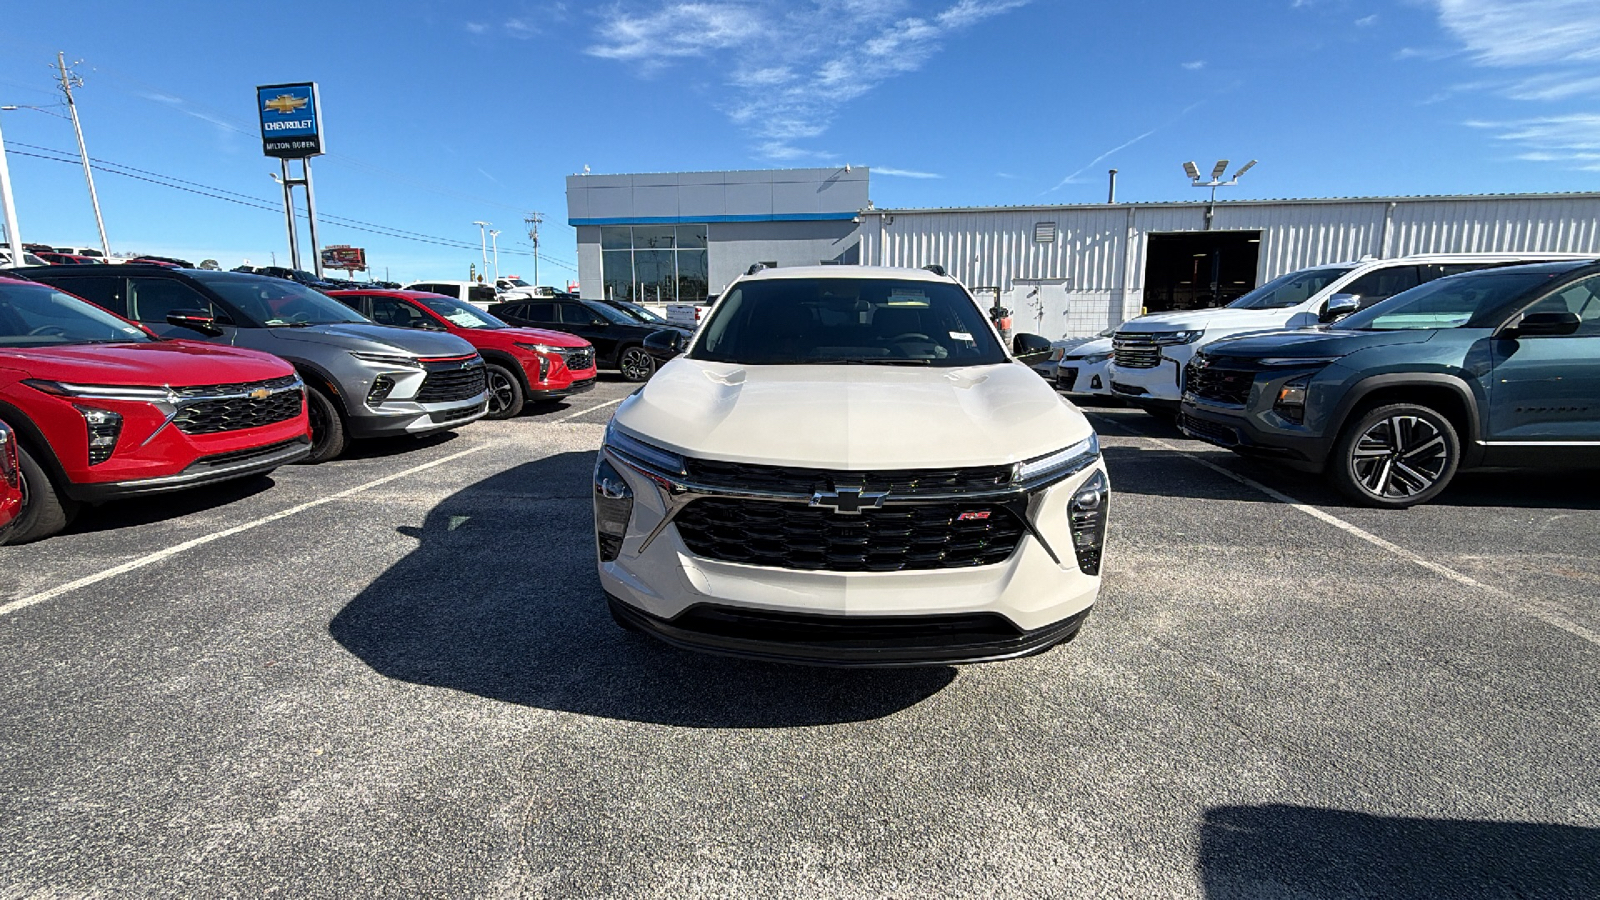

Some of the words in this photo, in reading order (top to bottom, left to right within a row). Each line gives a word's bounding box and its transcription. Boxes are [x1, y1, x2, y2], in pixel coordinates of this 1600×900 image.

[264, 119, 312, 131] CHEVROLET
[266, 142, 291, 150] MILTON
[957, 511, 992, 521] RS
